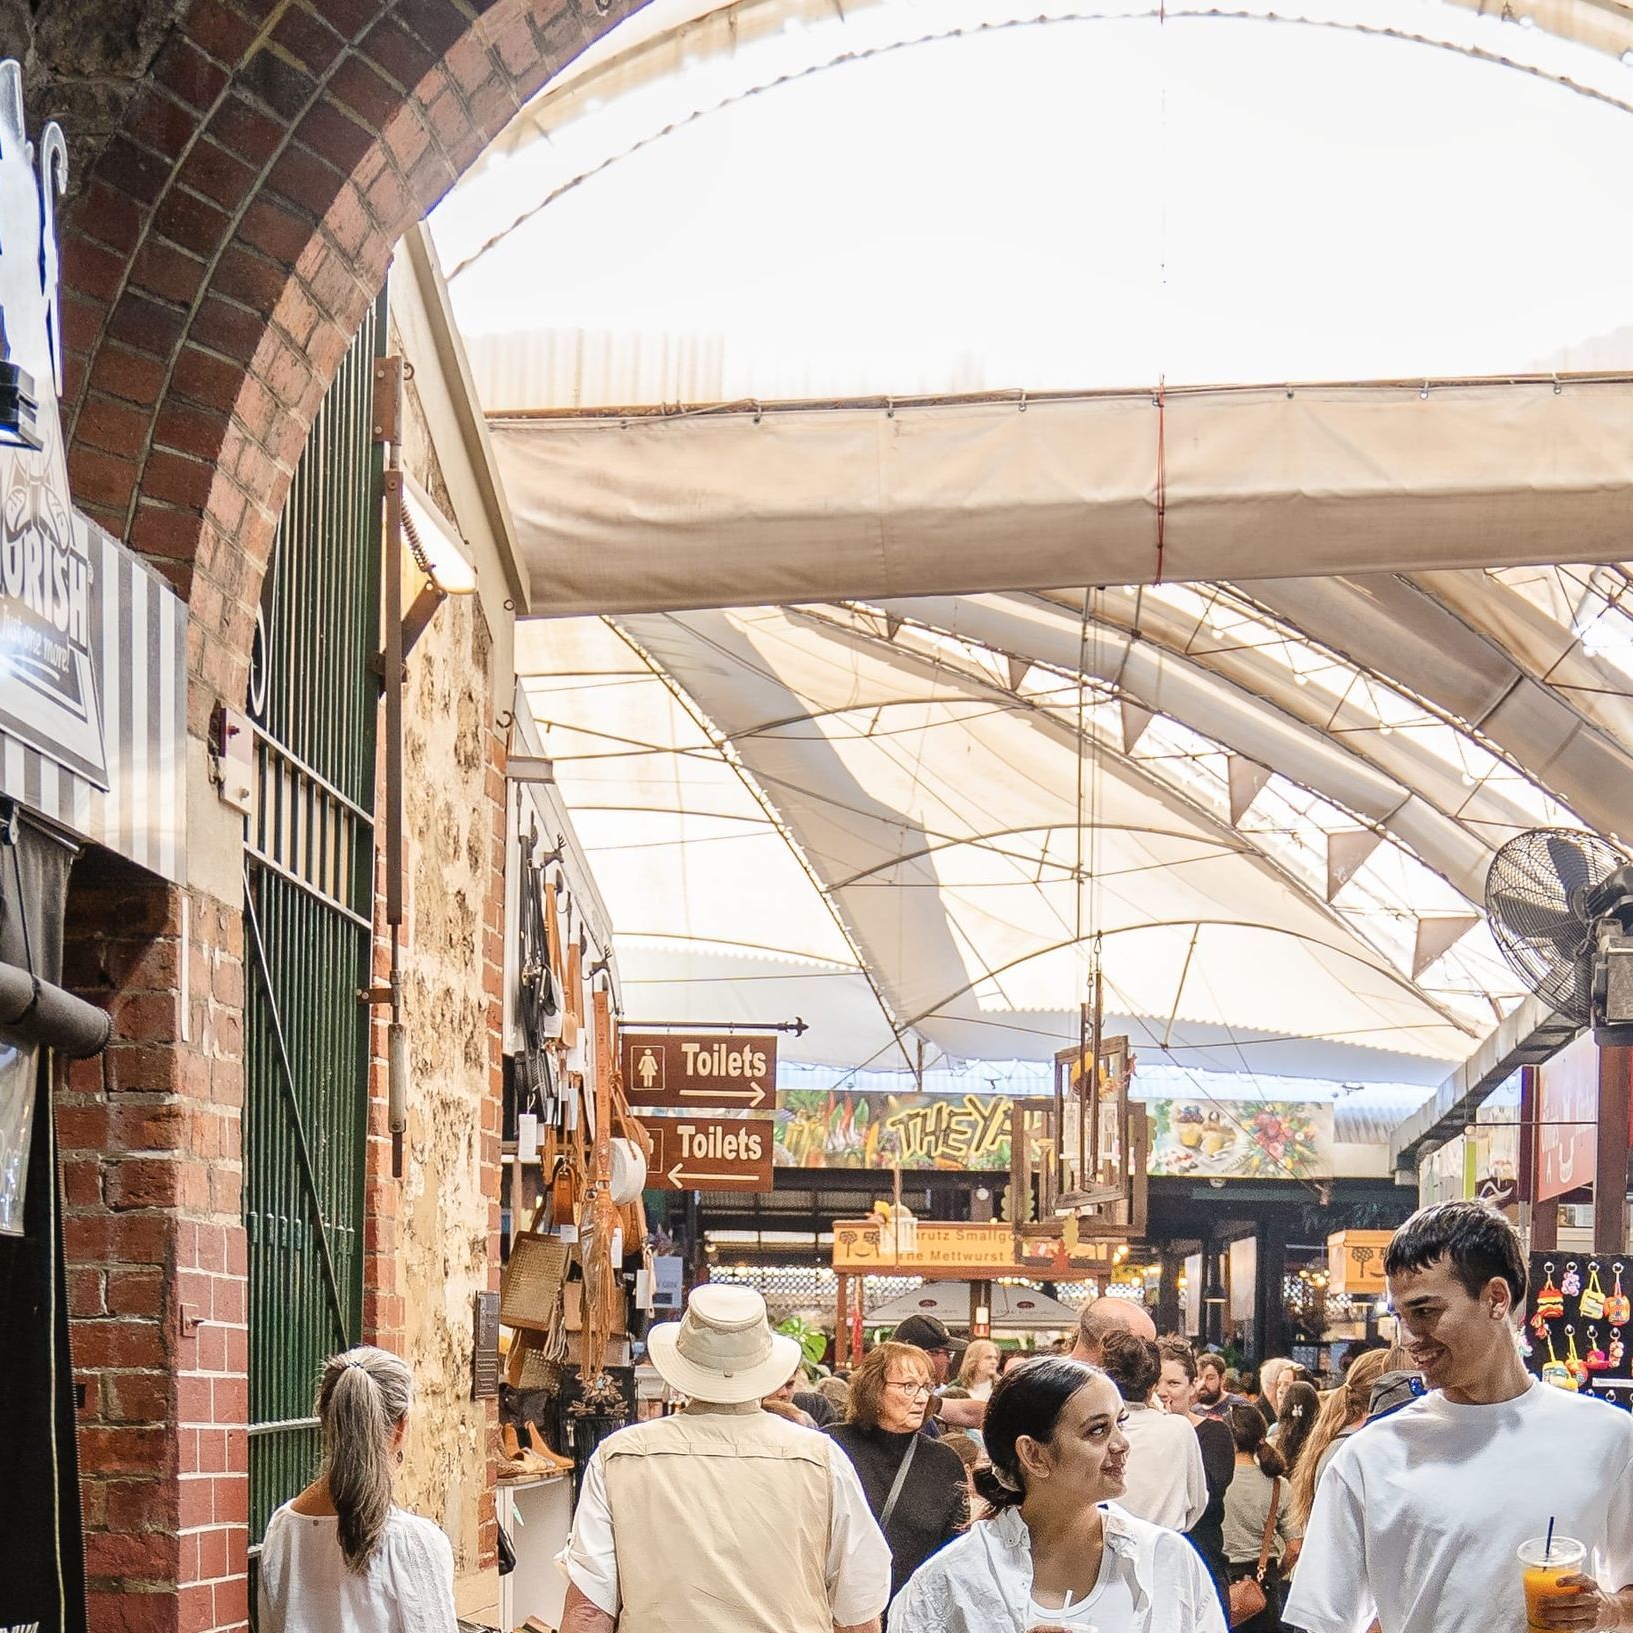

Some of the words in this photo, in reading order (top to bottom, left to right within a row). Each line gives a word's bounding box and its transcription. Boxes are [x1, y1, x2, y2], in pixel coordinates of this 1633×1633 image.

[24, 625, 42, 655] one
[681, 1043, 766, 1078] Toilets
[677, 1125, 762, 1161] Toilets
[931, 1250, 1004, 1262] Mettwurst
